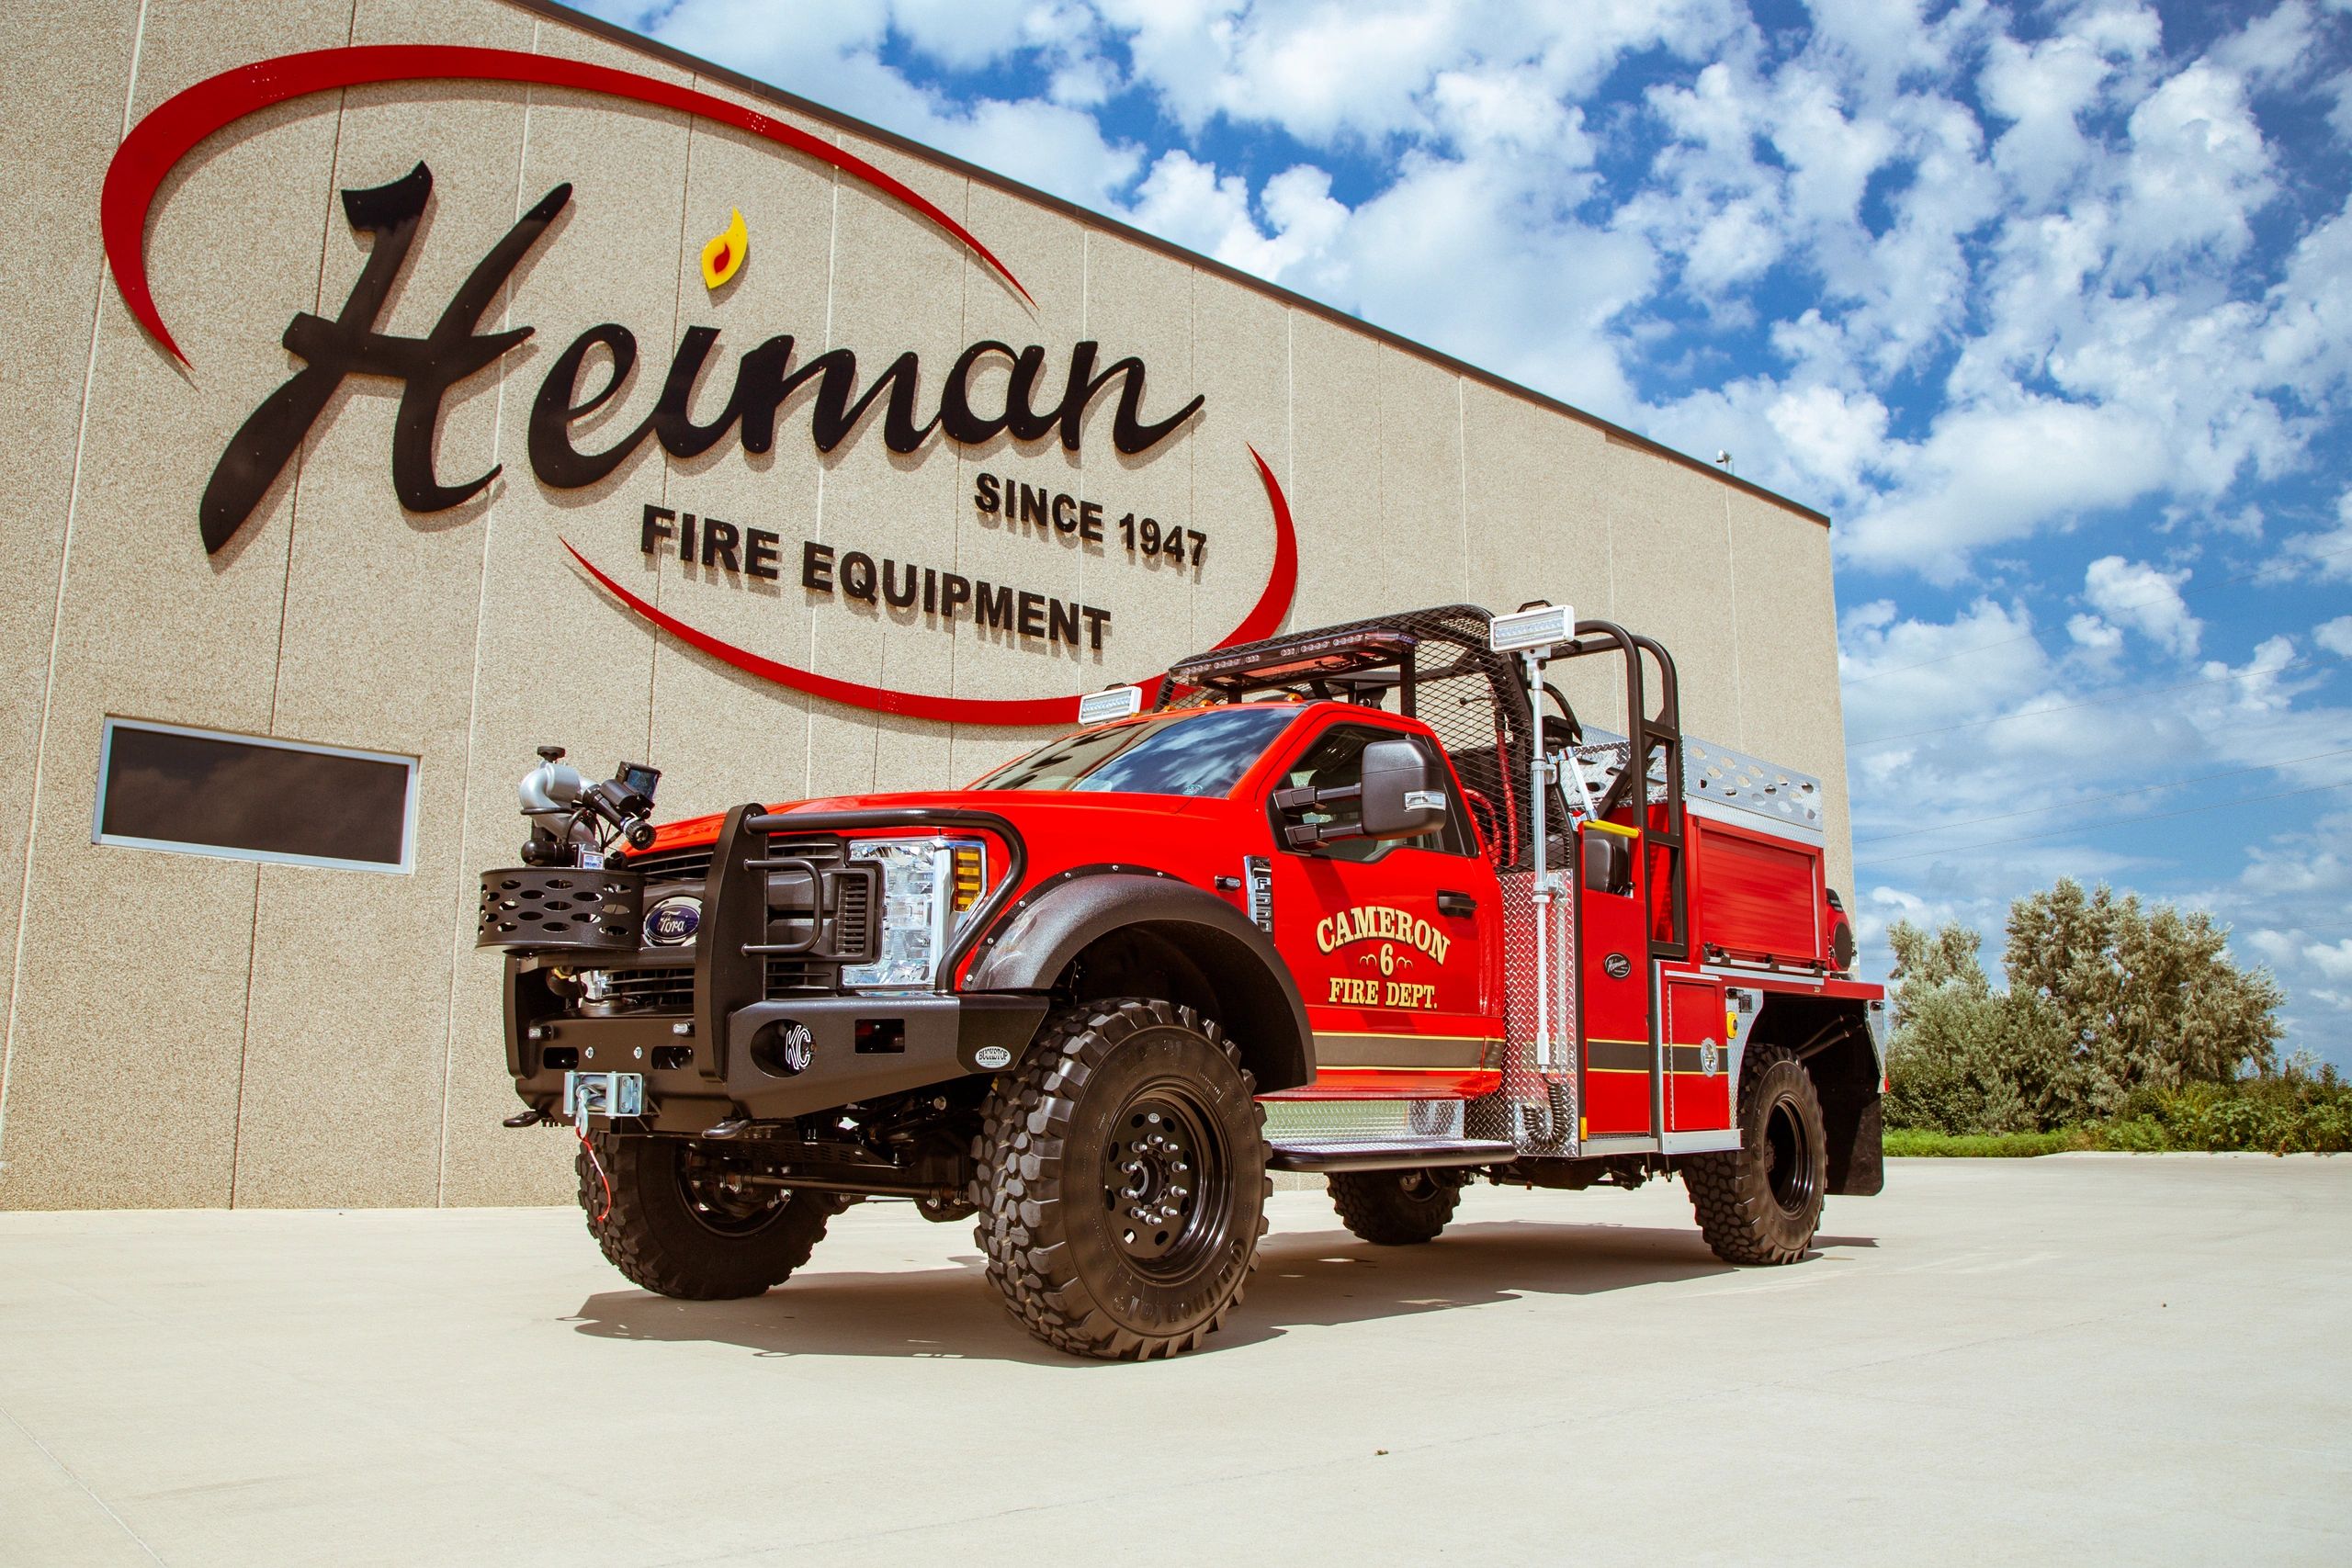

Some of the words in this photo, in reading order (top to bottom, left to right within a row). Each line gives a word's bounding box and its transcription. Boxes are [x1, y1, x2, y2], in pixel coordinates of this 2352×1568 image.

[199, 160, 1205, 554] Heiman
[975, 473, 1103, 542] SINCE
[1118, 513, 1206, 566] 1947
[642, 505, 780, 581] FIRE
[802, 540, 1111, 649] EQUIPMENT
[657, 910, 687, 933] Ford
[1317, 906, 1451, 965] CAMERON
[1380, 943, 1394, 976] 6
[1329, 977, 1379, 1005] FIRE
[1385, 982, 1438, 1010] DEPT.
[786, 1025, 811, 1070] KC
